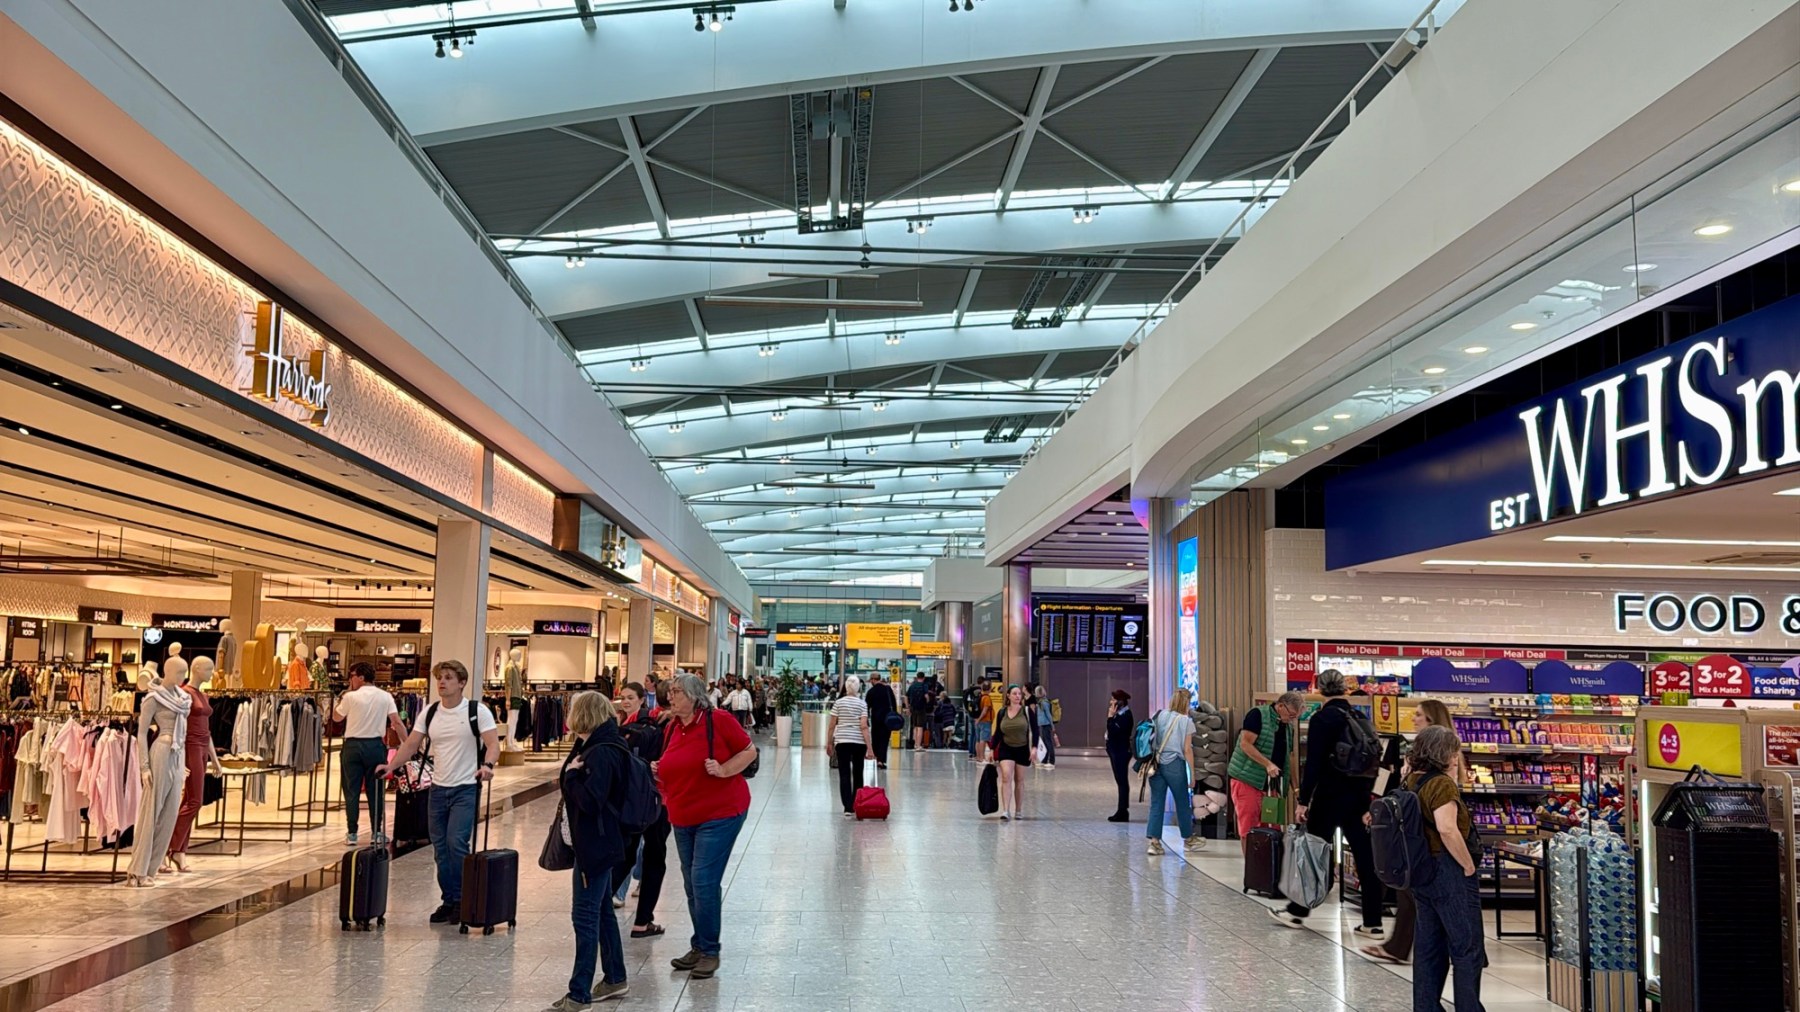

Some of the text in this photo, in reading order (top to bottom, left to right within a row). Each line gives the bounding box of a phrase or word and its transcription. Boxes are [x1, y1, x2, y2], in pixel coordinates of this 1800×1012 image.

[260, 301, 332, 426] Harrods
[1490, 493, 1530, 531] EST
[1615, 592, 1800, 633] FOOD &
[163, 620, 211, 630] MONTBLANC
[356, 620, 400, 632] Barbour
[543, 624, 575, 632] CANADA
[1336, 646, 1380, 654] Meal Deal
[1422, 648, 1443, 656] Meal
[1503, 650, 1524, 658] Meal
[1288, 652, 1313, 661] Meal
[1288, 662, 1313, 671] Deal
[1451, 674, 1490, 683] WHSmith
[1656, 671, 1667, 686] 3
[1679, 671, 1690, 686] 2
[1698, 665, 1712, 684] 3
[1728, 666, 1742, 684] 2
[1570, 677, 1605, 686] WHSmith
[1754, 677, 1799, 686] Food Gifts
[1763, 687, 1796, 696] Sharing
[1661, 734, 1667, 746] 4
[1671, 735, 1677, 748] 3
[1584, 762, 1596, 775] 3 2
[1705, 801, 1752, 812] WHSmith
